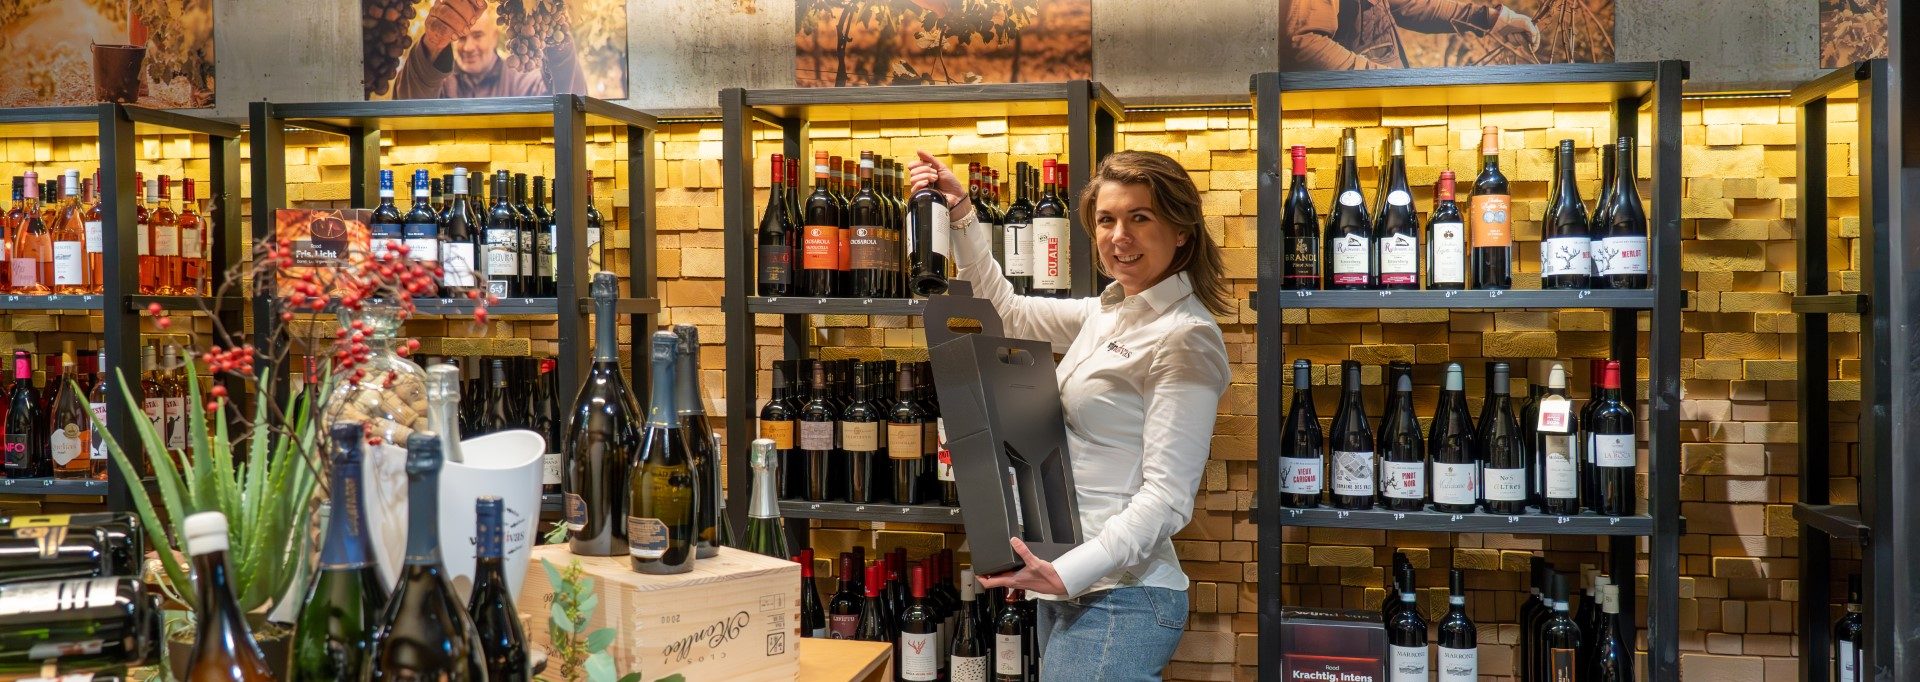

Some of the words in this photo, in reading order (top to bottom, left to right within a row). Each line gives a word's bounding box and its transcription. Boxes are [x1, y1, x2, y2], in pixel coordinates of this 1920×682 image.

[1621, 249, 1642, 258] MERLOT
[687, 652, 727, 665] CLOS
[1292, 670, 1339, 682] Krachtig,
[1340, 672, 1373, 682] Intens
